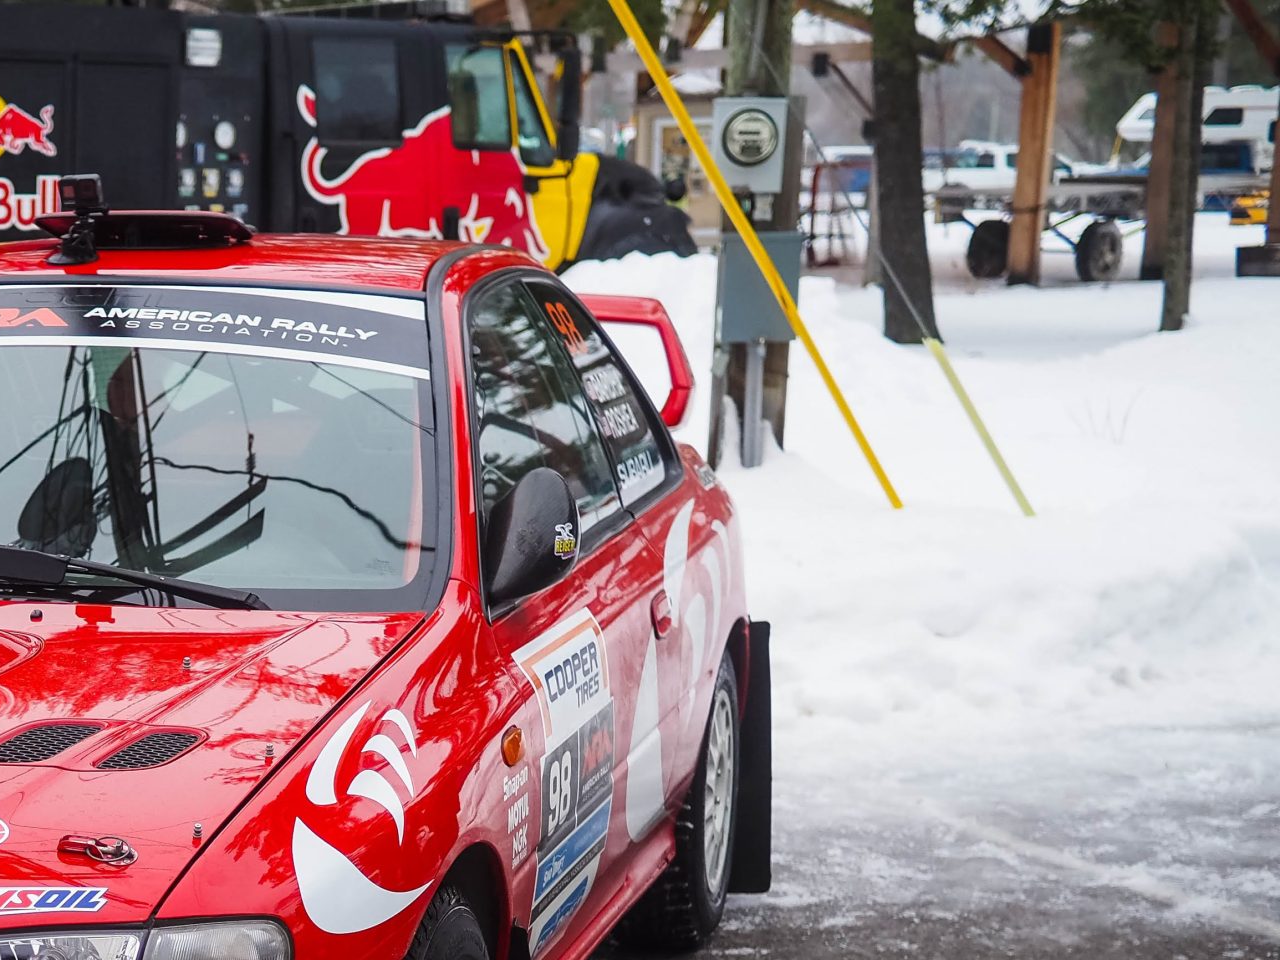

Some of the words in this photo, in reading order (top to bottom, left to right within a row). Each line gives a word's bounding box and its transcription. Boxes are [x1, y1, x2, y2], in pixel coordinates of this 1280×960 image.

[83, 307, 261, 327] AMERICAN
[270, 318, 378, 341] RALLY
[544, 641, 599, 703] COOPER
[576, 672, 600, 708] TIRES
[508, 792, 529, 834] MOTUL
[548, 750, 572, 837] 98
[513, 824, 527, 856] NGK
